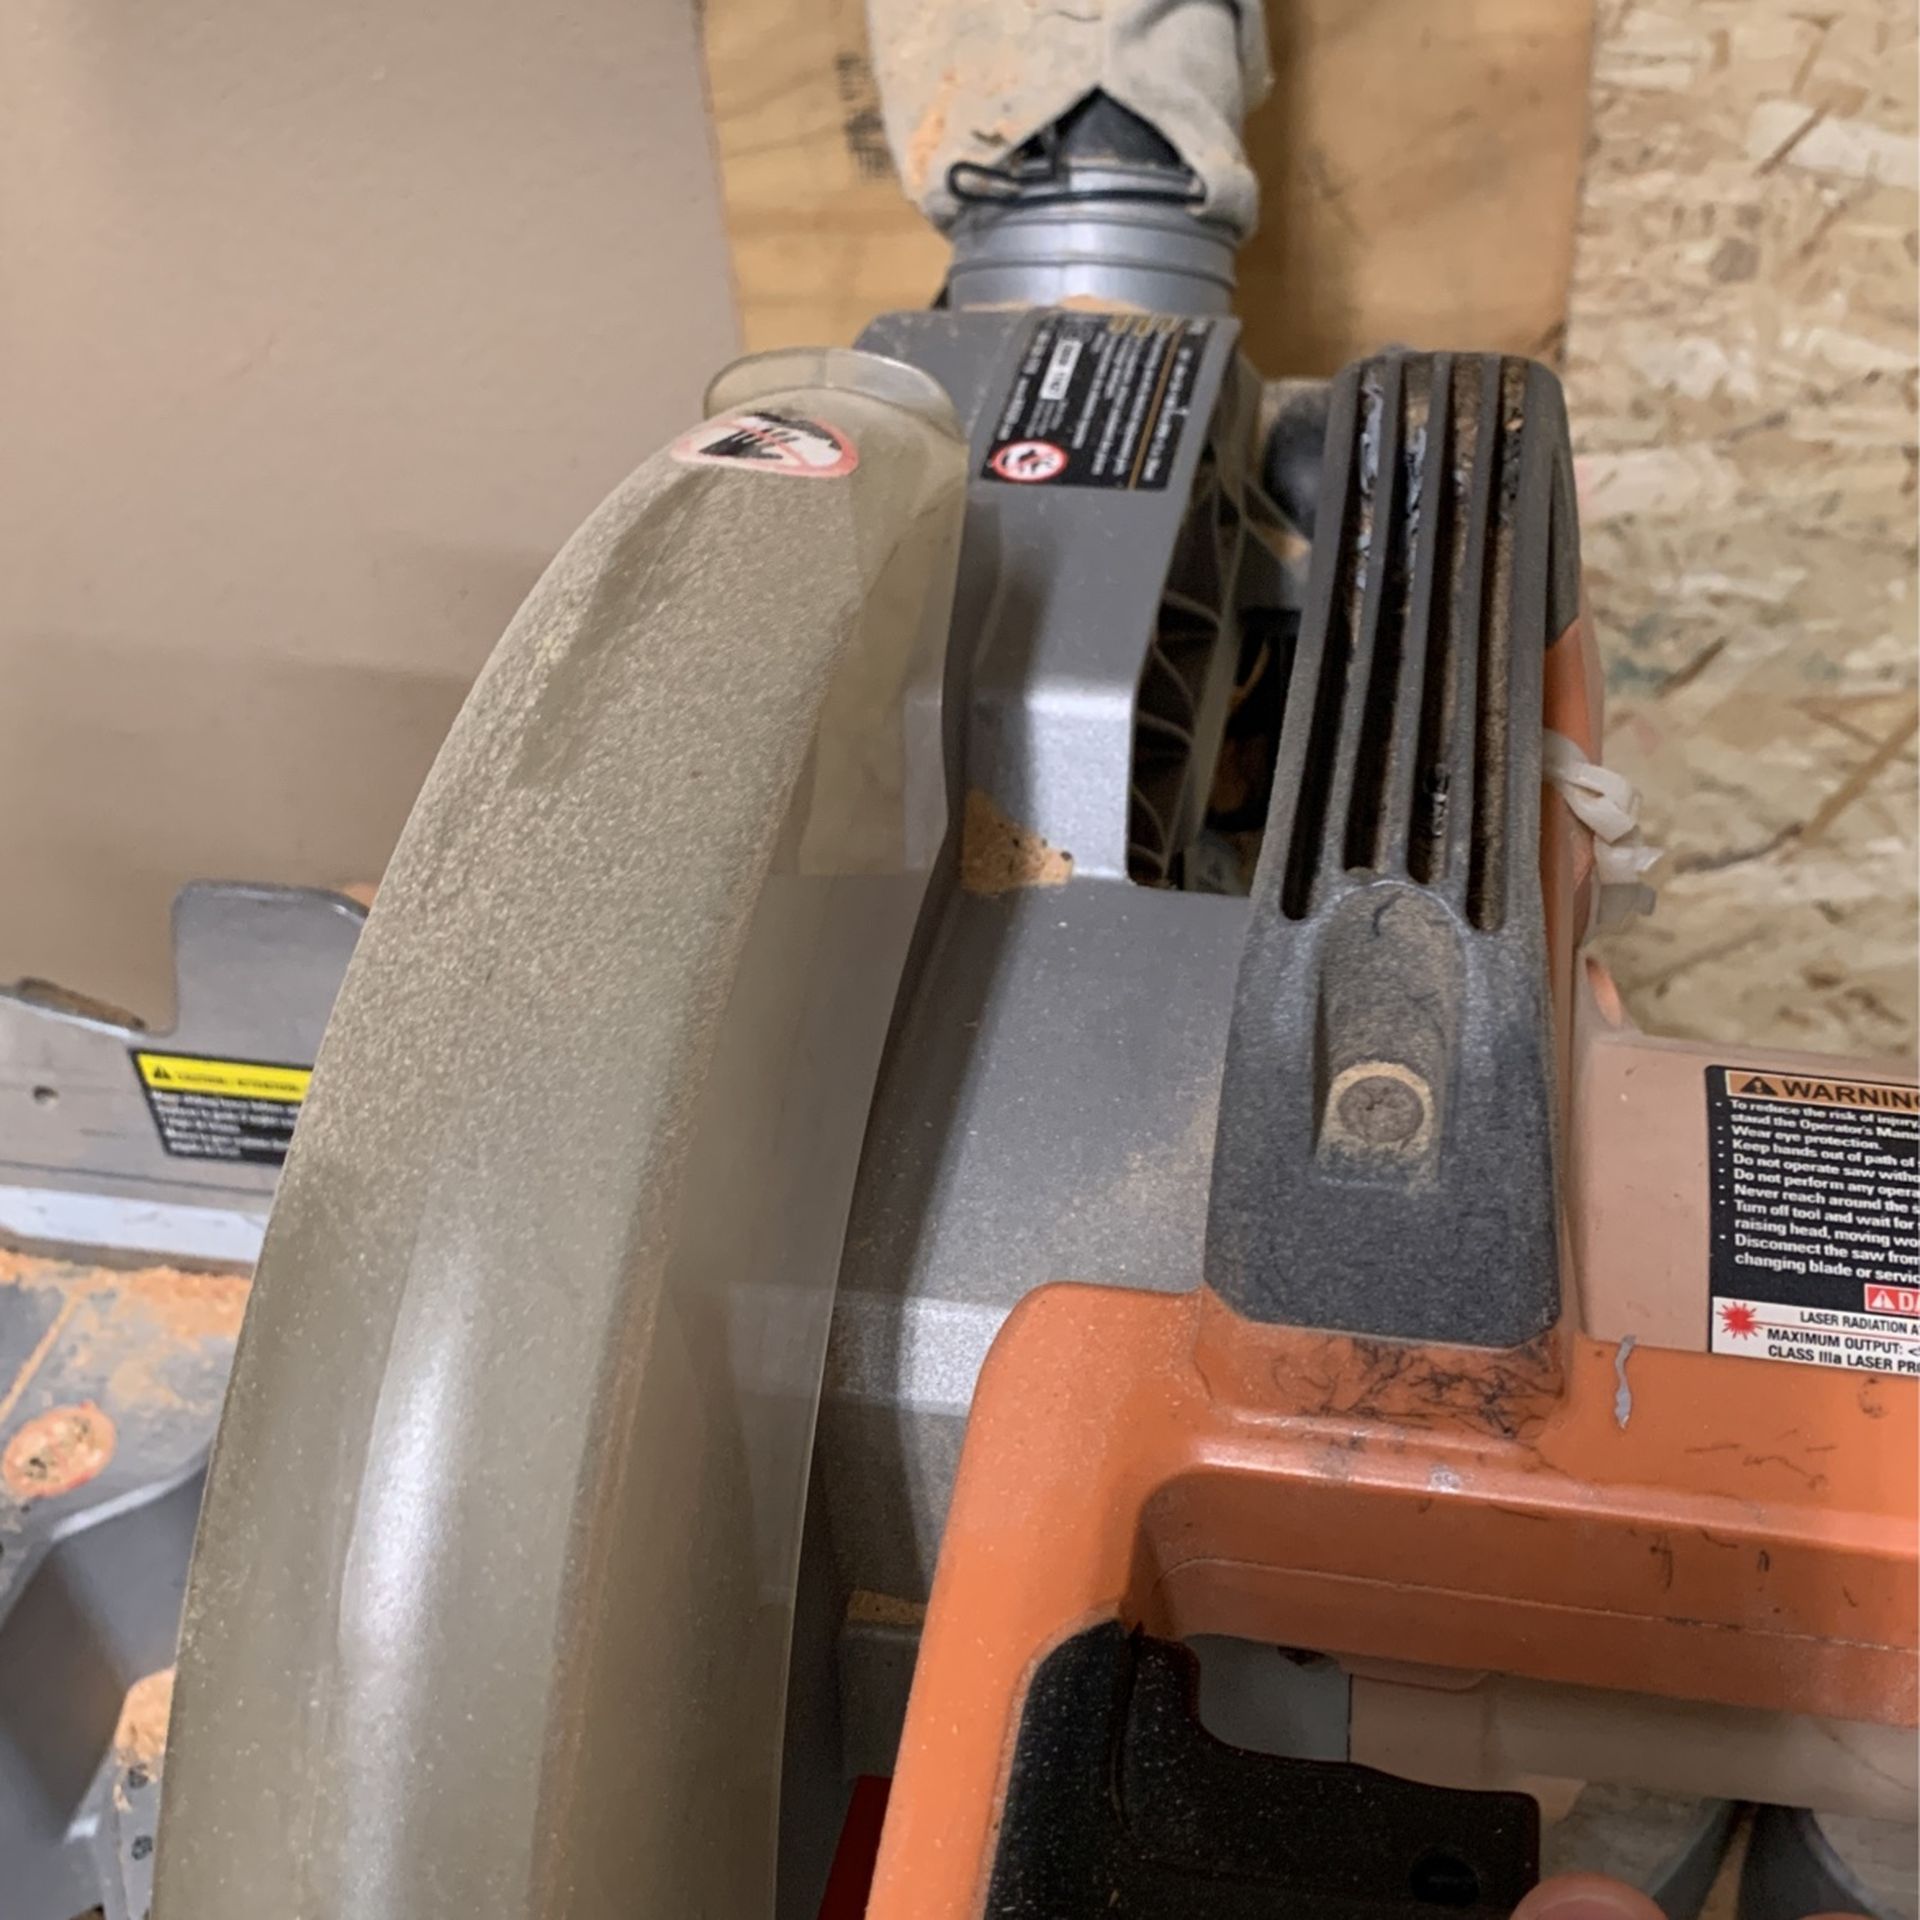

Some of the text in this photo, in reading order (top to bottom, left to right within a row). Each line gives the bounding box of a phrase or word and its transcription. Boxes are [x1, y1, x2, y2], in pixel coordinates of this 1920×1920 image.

[1730, 1100, 1747, 1110] To
[1750, 1104, 1800, 1115] reduce
[1803, 1107, 1826, 1118] the
[1829, 1112, 1856, 1121] risk
[1860, 1114, 1874, 1122] of
[1731, 1114, 1770, 1125] stand
[1773, 1117, 1796, 1127] the
[1800, 1119, 1873, 1136] Operator's
[1731, 1125, 1882, 1150] Wear eye protection.
[1732, 1139, 1770, 1154] Keep
[1772, 1143, 1818, 1157] hands
[1821, 1151, 1844, 1160] out
[1847, 1152, 1861, 1162] of
[1864, 1155, 1897, 1166] path
[1900, 1157, 1915, 1167] of
[1733, 1153, 1754, 1165] Do
[1757, 1158, 1780, 1168] not
[1783, 1161, 1840, 1175] operate
[1843, 1168, 1875, 1178] saw
[1733, 1168, 1755, 1180] Do
[1757, 1173, 1781, 1184] not
[1783, 1176, 1844, 1190] perform
[1847, 1183, 1875, 1196] any
[1734, 1183, 1779, 1199] Never
[1782, 1191, 1826, 1204] reach
[1828, 1196, 1881, 1210] around
[1884, 1200, 1909, 1213] the
[1734, 1199, 1767, 1214] Turn
[1770, 1204, 1790, 1217] off
[1792, 1207, 1821, 1220] tool
[1824, 1211, 1853, 1223] and
[1855, 1215, 1890, 1228] wait
[1893, 1217, 1915, 1230] for
[1735, 1217, 1920, 1248] raising head, moving wo
[1735, 1233, 1821, 1255] Disconnect
[1823, 1243, 1848, 1258] the
[1851, 1250, 1885, 1261] saw
[1735, 1252, 1806, 1274] changing
[1809, 1259, 1853, 1276] blade
[1856, 1267, 1872, 1278] or
[1800, 1311, 1839, 1326] LASER
[1842, 1316, 1908, 1333] RADIATION
[1767, 1328, 1840, 1347] MAXIMUM
[1844, 1337, 1903, 1355] OUTPUT:
[1768, 1344, 1815, 1361] CLASS
[1847, 1355, 1893, 1370] LASER
